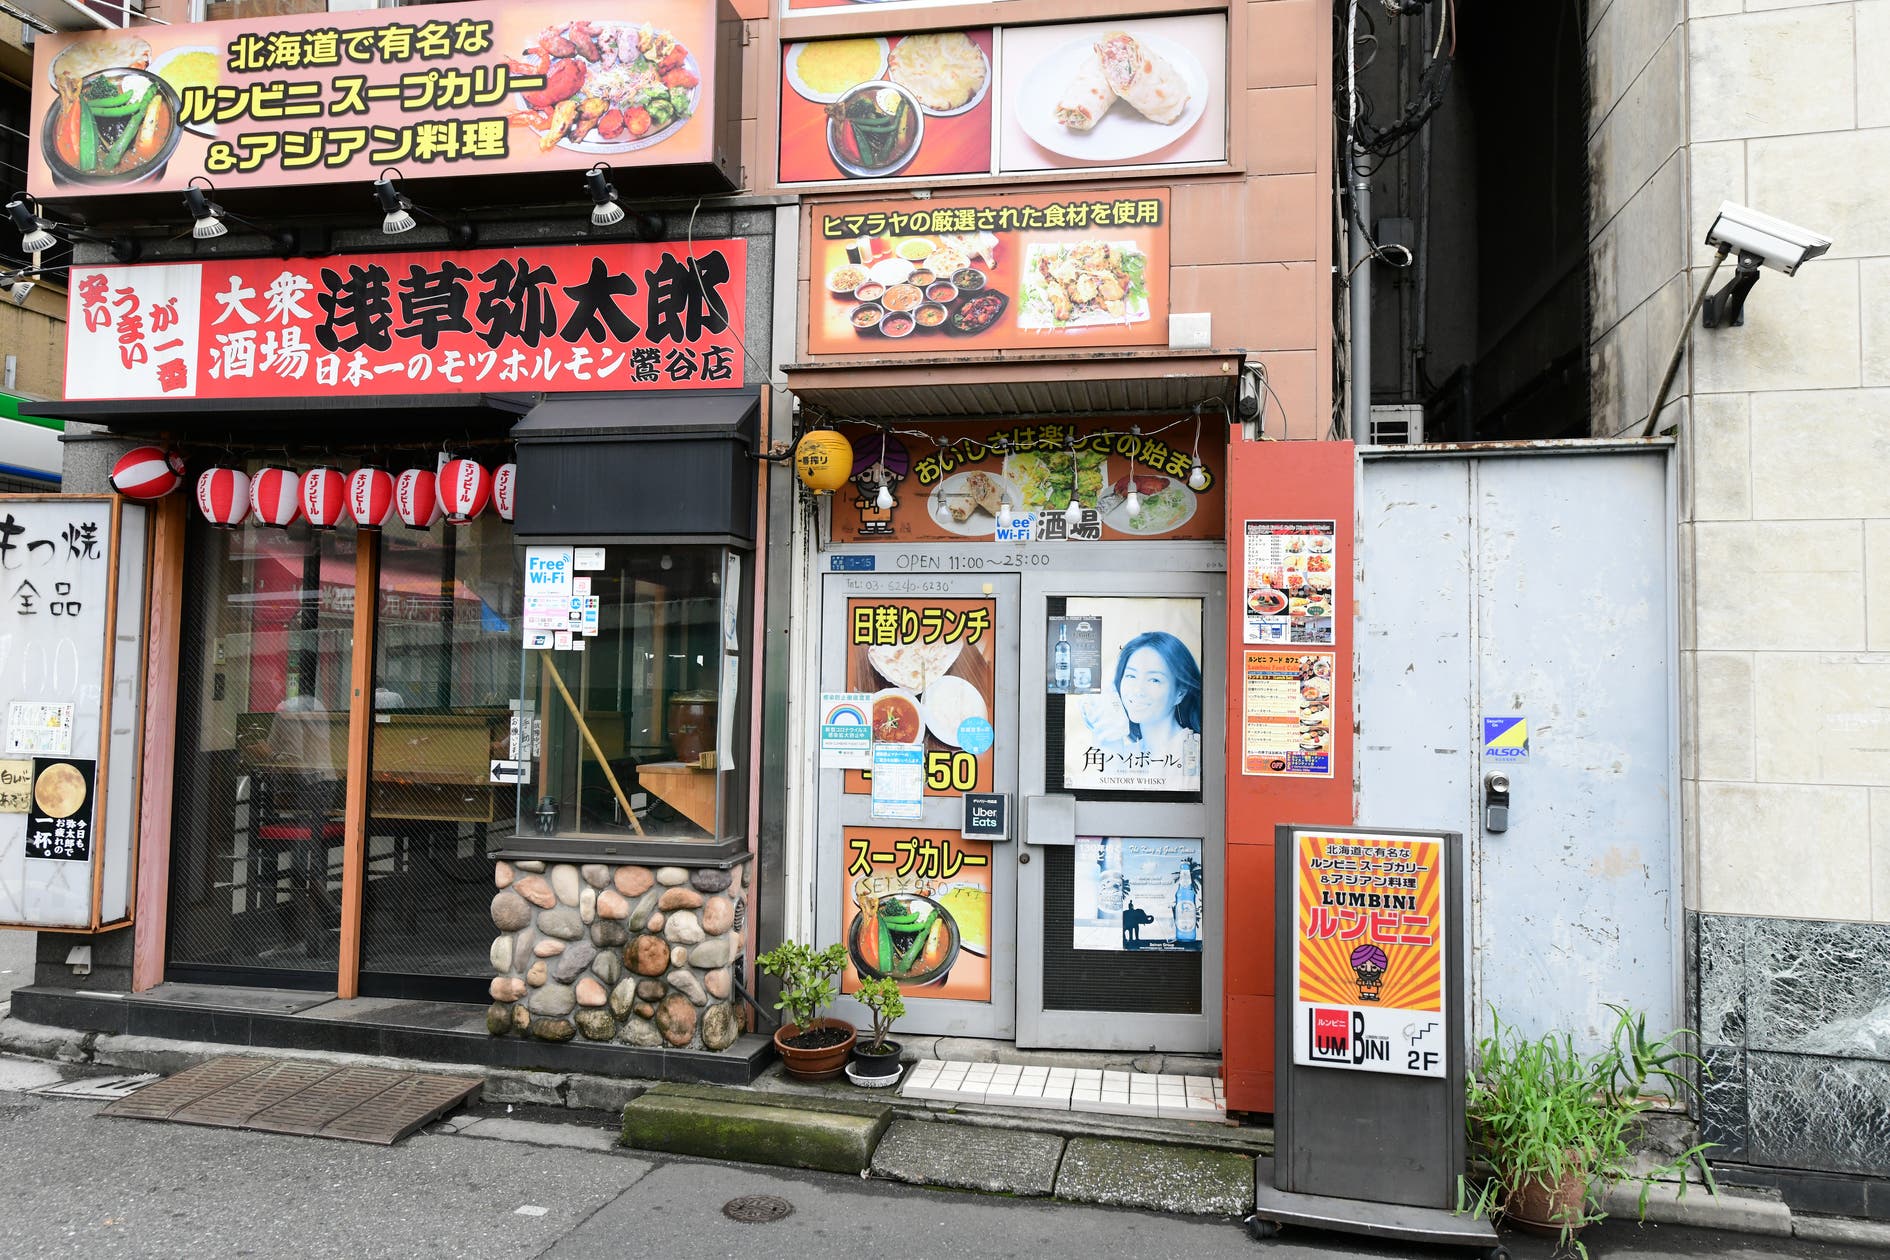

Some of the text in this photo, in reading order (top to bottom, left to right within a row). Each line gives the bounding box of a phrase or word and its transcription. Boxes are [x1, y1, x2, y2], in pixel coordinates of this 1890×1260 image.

[230, 22, 489, 70] 北海道で有名な
[179, 67, 544, 124] ルンビニ スープカリー
[207, 120, 506, 171] &アジアン料理
[823, 200, 1159, 237] ヒマラヤの厳選された食材を使用
[79, 273, 112, 333] 安い
[211, 271, 313, 325] 大衆
[315, 250, 730, 352] 浅草弥太郎
[112, 287, 148, 369] うまい
[149, 297, 187, 392] が一番
[208, 326, 311, 379] 酒場
[316, 345, 734, 387] 日本一のモツホルモン 鶯谷店
[310, 474, 319, 515] キリンビール
[355, 473, 365, 515] キリンビール
[400, 474, 412, 516] キリンビール
[460, 463, 473, 503] キリンビール
[997, 529, 1030, 540] Wi-Fi
[530, 557, 564, 570] Free
[530, 572, 564, 583] Wi-Fi
[896, 555, 940, 571] OPEN
[10, 579, 81, 616] 全品
[854, 606, 989, 645] 日替りランチ
[1486, 748, 1526, 757] ALSOK
[1099, 777, 1166, 785] SUNTORY WHISKY
[973, 807, 997, 817] Uber
[973, 817, 997, 827] Eats
[33, 817, 54, 857] 一杯。
[64, 819, 76, 856] 弥太郎で
[1327, 845, 1410, 858] 北海道で有名な
[849, 838, 986, 878] スープカレー
[1310, 858, 1428, 873] ルンビニ スープカリー
[862, 877, 893, 895] SET
[1321, 874, 1417, 888] &アジアン料理
[1322, 891, 1416, 910] LUMBINI
[1307, 907, 1432, 945] ルンビニ
[1408, 1050, 1438, 1071] 2F
